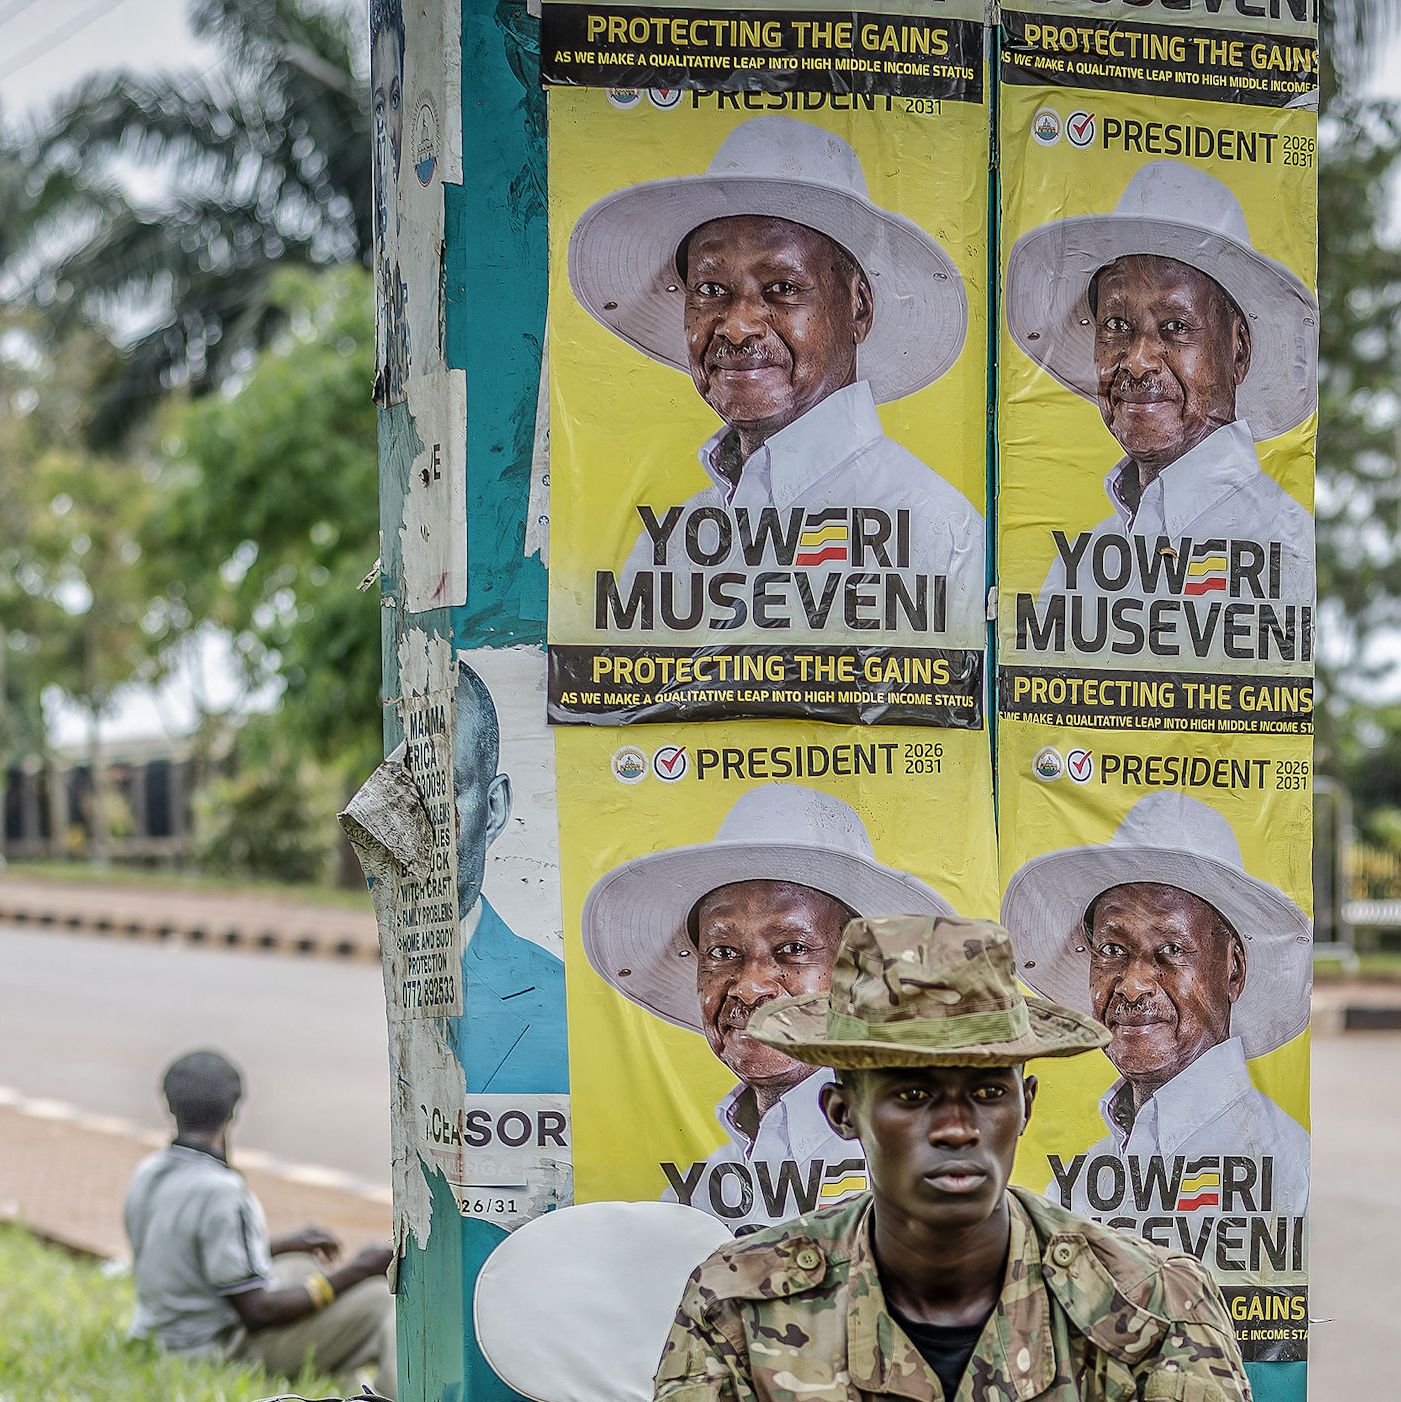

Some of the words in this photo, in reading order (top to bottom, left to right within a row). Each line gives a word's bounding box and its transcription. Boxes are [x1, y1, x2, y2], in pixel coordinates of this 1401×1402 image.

[586, 14, 782, 48] PROTECTING
[791, 21, 853, 49] THE
[860, 23, 949, 56] GAINS
[1024, 23, 1186, 63] PROTECTING
[1193, 37, 1244, 67] THE
[1250, 43, 1319, 75] GAINS
[554, 50, 572, 64] AS
[573, 51, 595, 65] WE
[597, 52, 635, 67] MAKE
[637, 53, 647, 66] A
[649, 53, 731, 69] QUALITATIVE
[733, 56, 766, 70] LEAP
[768, 57, 798, 70] INTO
[801, 57, 832, 71] HIGH
[834, 58, 881, 73] MIDDLE
[883, 61, 930, 77] INCOME
[932, 66, 975, 81] STATUS
[1014, 54, 1032, 67] WE
[1034, 56, 1065, 72] MAKE
[1066, 61, 1075, 73] A
[1076, 62, 1144, 80] QUALITATIVE
[1146, 69, 1173, 82] LEAP
[1174, 71, 1200, 85] INTO
[1201, 74, 1227, 87] HIGH
[1229, 76, 1268, 91] MIDDLE
[1270, 80, 1312, 94] INCOME
[905, 99, 943, 115] 2031
[1103, 117, 1278, 164] PRESIDENT
[1283, 135, 1315, 153] 2026
[1283, 151, 1313, 168] 2031
[636, 506, 910, 568] YOWERI
[1051, 530, 1282, 600] YOWERI
[595, 571, 947, 633] MUSEVENI
[1015, 592, 1312, 662] MUSEVENI
[592, 655, 785, 685] PROTECTING
[794, 655, 856, 683] THE
[863, 657, 950, 685] GAINS
[560, 691, 578, 705] AS
[580, 692, 601, 705] WE
[604, 692, 641, 706] MAKE
[643, 694, 653, 705] A
[654, 689, 735, 704] QUALITATIVE
[737, 690, 770, 703] LEAP
[771, 690, 802, 703] INTO
[804, 690, 835, 703] HIGH
[837, 691, 885, 704] MIDDLE
[887, 692, 933, 706] INCOME
[934, 694, 974, 708] STATUS
[1014, 676, 1175, 709] PROTECTING
[1182, 683, 1233, 711] THE
[1239, 686, 1313, 714] GAINS
[409, 704, 446, 741] MAAMA
[1022, 712, 1054, 725] MAKE
[1055, 713, 1064, 726] A
[1065, 714, 1133, 728] QUALITATIVE
[1135, 715, 1162, 729] LEAP
[1163, 717, 1189, 730] INTO
[1190, 718, 1216, 731] HIGH
[1217, 719, 1258, 733] MIDDLE
[1259, 720, 1299, 734] INCOME
[407, 741, 437, 772] FRICA
[697, 743, 899, 781] PRESIDENT
[904, 742, 944, 759] 2026
[904, 759, 942, 774] 2031
[1101, 753, 1271, 790] PRESIDENT
[1275, 760, 1310, 776] 2026
[1275, 776, 1307, 791] 2031
[400, 880, 425, 903] WITCH
[426, 876, 452, 899] CRAFT
[423, 901, 454, 925] PROBLEMS
[421, 930, 435, 951] AND
[436, 927, 454, 949] BODY
[408, 951, 448, 977] PROTECTION
[402, 979, 423, 1009] 0772
[424, 975, 455, 1007] 892533
[659, 1158, 867, 1219] YOWE
[1046, 1154, 1274, 1213] YOWERI
[1231, 1295, 1306, 1321] GAINS
[1250, 1329, 1290, 1341] INCOME
